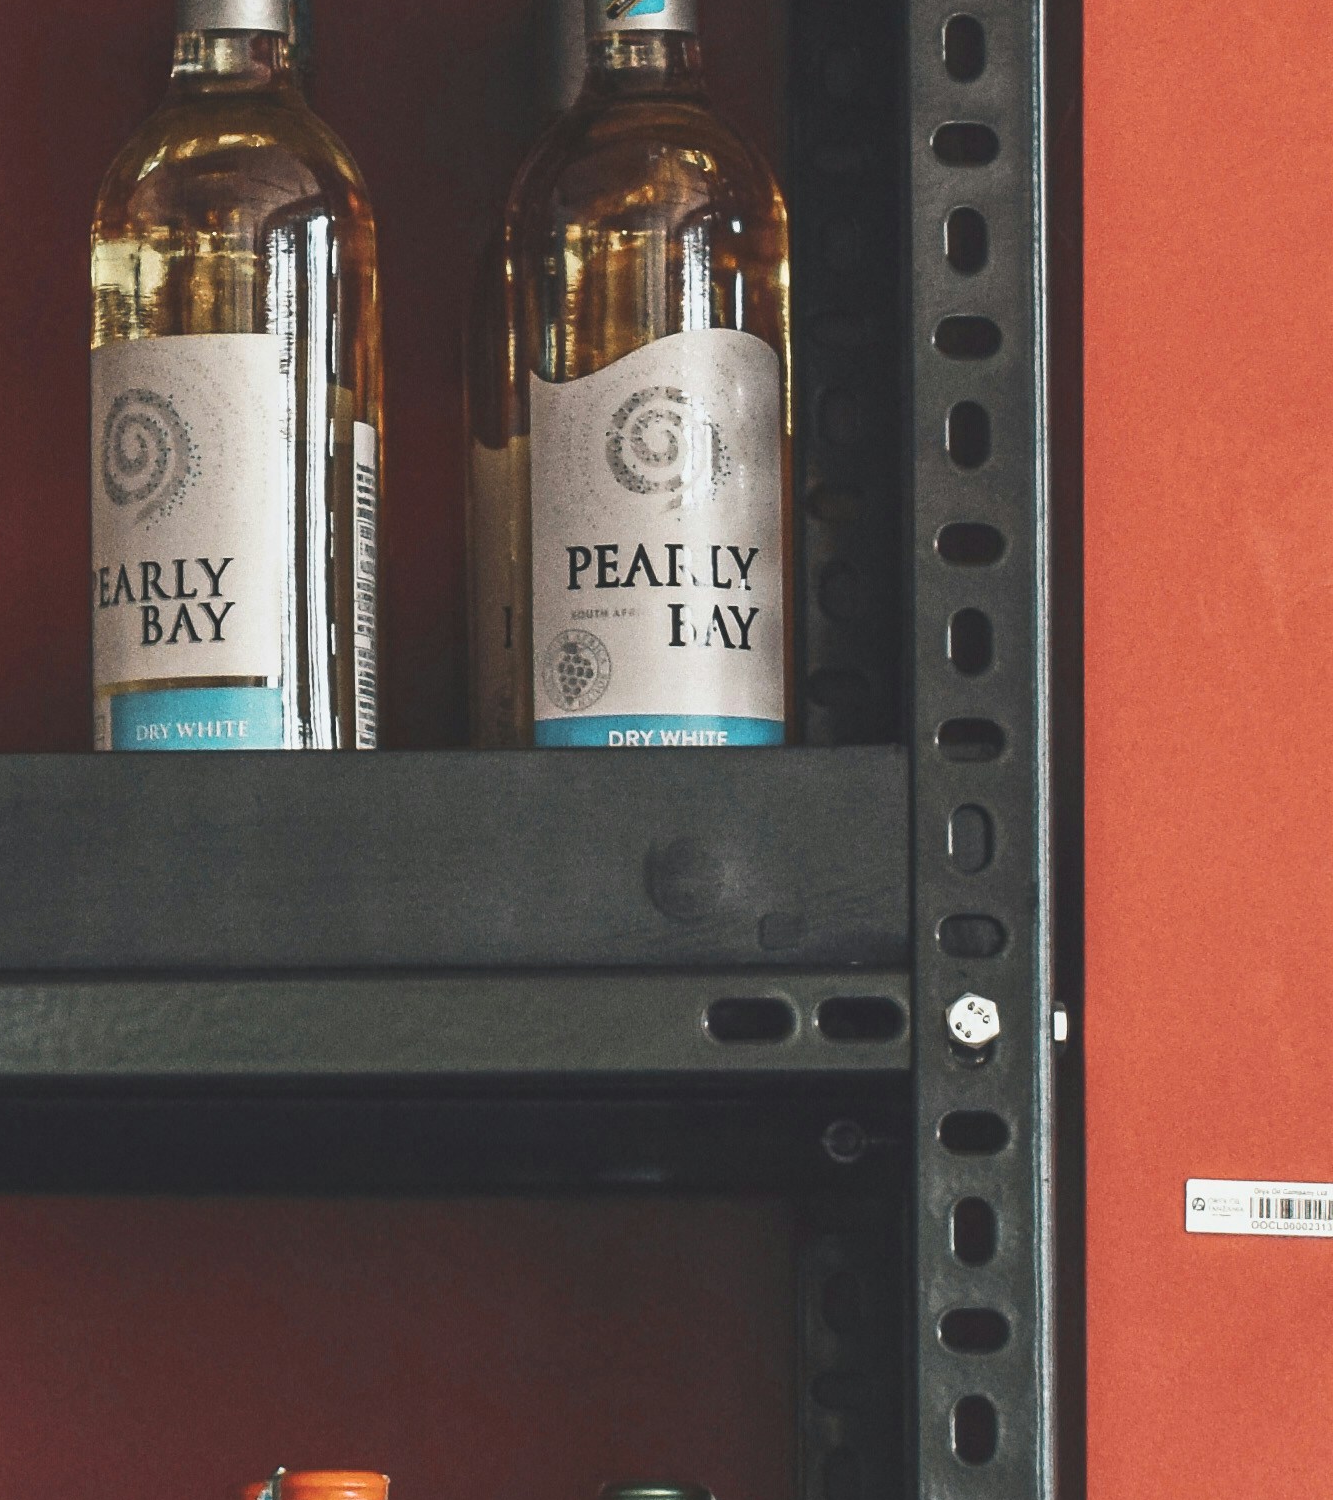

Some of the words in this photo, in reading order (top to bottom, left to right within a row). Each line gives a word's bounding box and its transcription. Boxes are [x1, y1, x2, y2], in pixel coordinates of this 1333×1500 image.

[94, 558, 234, 610] EARLY
[565, 543, 760, 591] PEARLY
[140, 602, 236, 646] BAY
[667, 603, 760, 650] BAY
[136, 722, 171, 742] DRY
[176, 720, 249, 740] WHITE
[608, 729, 653, 746] DRY
[660, 729, 729, 746] WHITE
